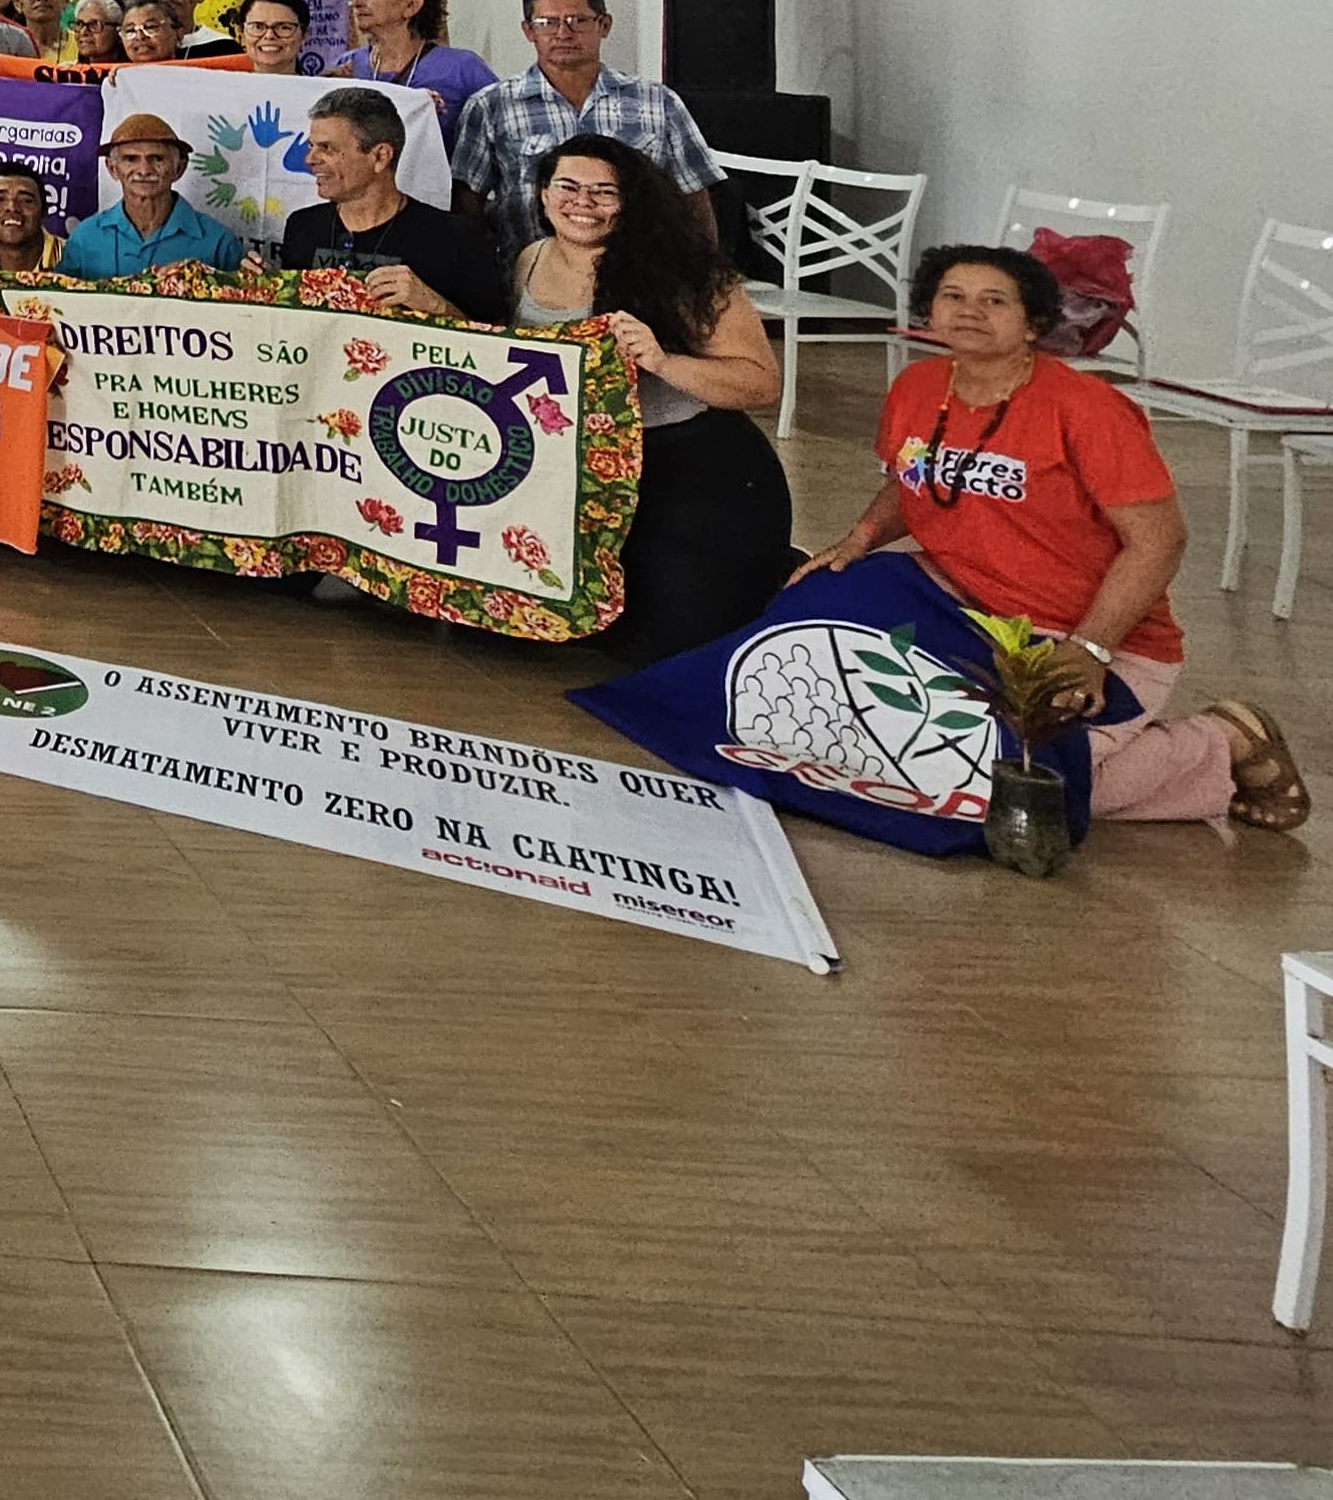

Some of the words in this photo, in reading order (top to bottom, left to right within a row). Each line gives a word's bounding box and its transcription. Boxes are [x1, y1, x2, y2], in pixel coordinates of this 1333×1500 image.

[59, 321, 233, 361] DIREITOS
[257, 340, 309, 364] SÃO
[412, 341, 477, 370] PELA
[95, 372, 142, 393] PRA
[154, 375, 300, 405] MULHERES
[395, 368, 494, 404] DIVISÃO
[113, 401, 129, 419] E
[138, 401, 248, 429] HOMENS
[46, 420, 363, 484] ESPONSABILIDADE
[372, 404, 434, 494] TRABALHO
[445, 425, 531, 503] DOMÉSTICO
[400, 416, 493, 454] JUSTA
[429, 448, 461, 471] DO
[131, 472, 243, 506] TAMBÉM
[104, 669, 121, 688] O
[135, 676, 389, 741] ASSENTAMENTO
[409, 726, 598, 785] BRANDÕES
[619, 769, 725, 812] QUER
[224, 717, 321, 755] VIVER
[341, 741, 361, 763] E
[380, 749, 572, 808] PRODUZIR.
[29, 728, 304, 806] DESMATAMENTO
[324, 790, 414, 832] ZERO
[436, 815, 492, 850] NA
[513, 832, 741, 908] CAATINGA!
[612, 891, 736, 930] misereor
